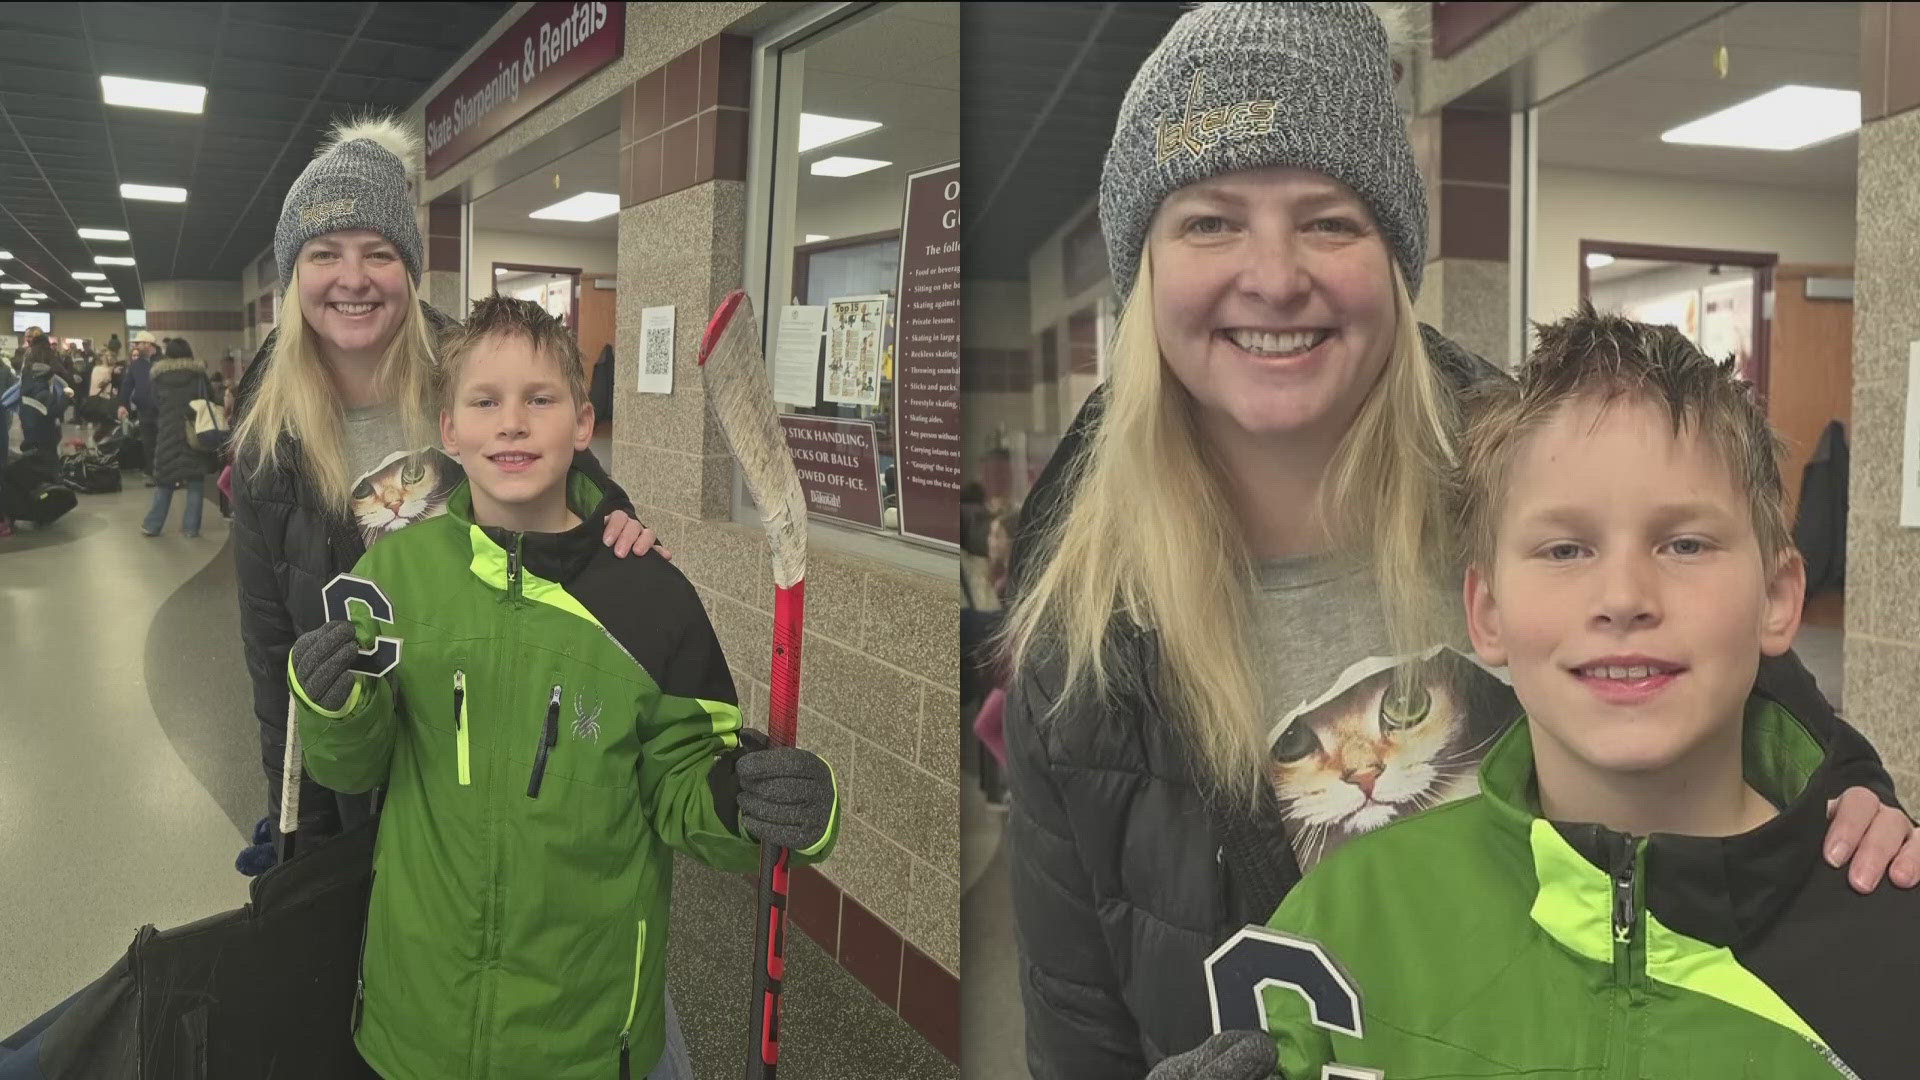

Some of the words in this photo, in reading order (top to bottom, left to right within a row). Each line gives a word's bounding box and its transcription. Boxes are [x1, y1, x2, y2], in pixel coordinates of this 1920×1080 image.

[427, 114, 452, 156] Skate
[453, 61, 519, 136] Sharpening
[522, 36, 535, 84] &
[539, 2, 608, 72] Rentals
[942, 209, 960, 229] G
[926, 245, 940, 256] The
[915, 268, 929, 277] Food
[914, 283, 932, 293] Sitting
[942, 282, 952, 290] the
[835, 304, 850, 313] Top
[851, 303, 859, 312] 15
[913, 301, 933, 310] Skating
[935, 299, 955, 309] against
[912, 318, 931, 326] Private
[911, 334, 932, 343] Skating
[933, 333, 939, 341] in
[940, 333, 954, 343] large
[911, 350, 934, 358] Reckless
[911, 366, 936, 376] Throwing
[910, 382, 927, 390] Sticks
[927, 383, 938, 391] and
[910, 398, 934, 408] Freestyle
[910, 414, 928, 424] Skating
[789, 428, 813, 440] STICK
[814, 430, 869, 449] HANDLING,
[910, 430, 919, 439] Any
[920, 432, 937, 440] person
[938, 432, 958, 441] without
[910, 445, 931, 456] Carrying
[789, 448, 814, 461] UCKS
[815, 451, 829, 463] OR
[831, 454, 859, 468] BALLS
[936, 464, 944, 472] the
[827, 474, 868, 491] OFF-ICE.
[912, 475, 926, 486] Being
[934, 478, 942, 487] the
[943, 480, 951, 489] ice
[321, 572, 404, 677] C
